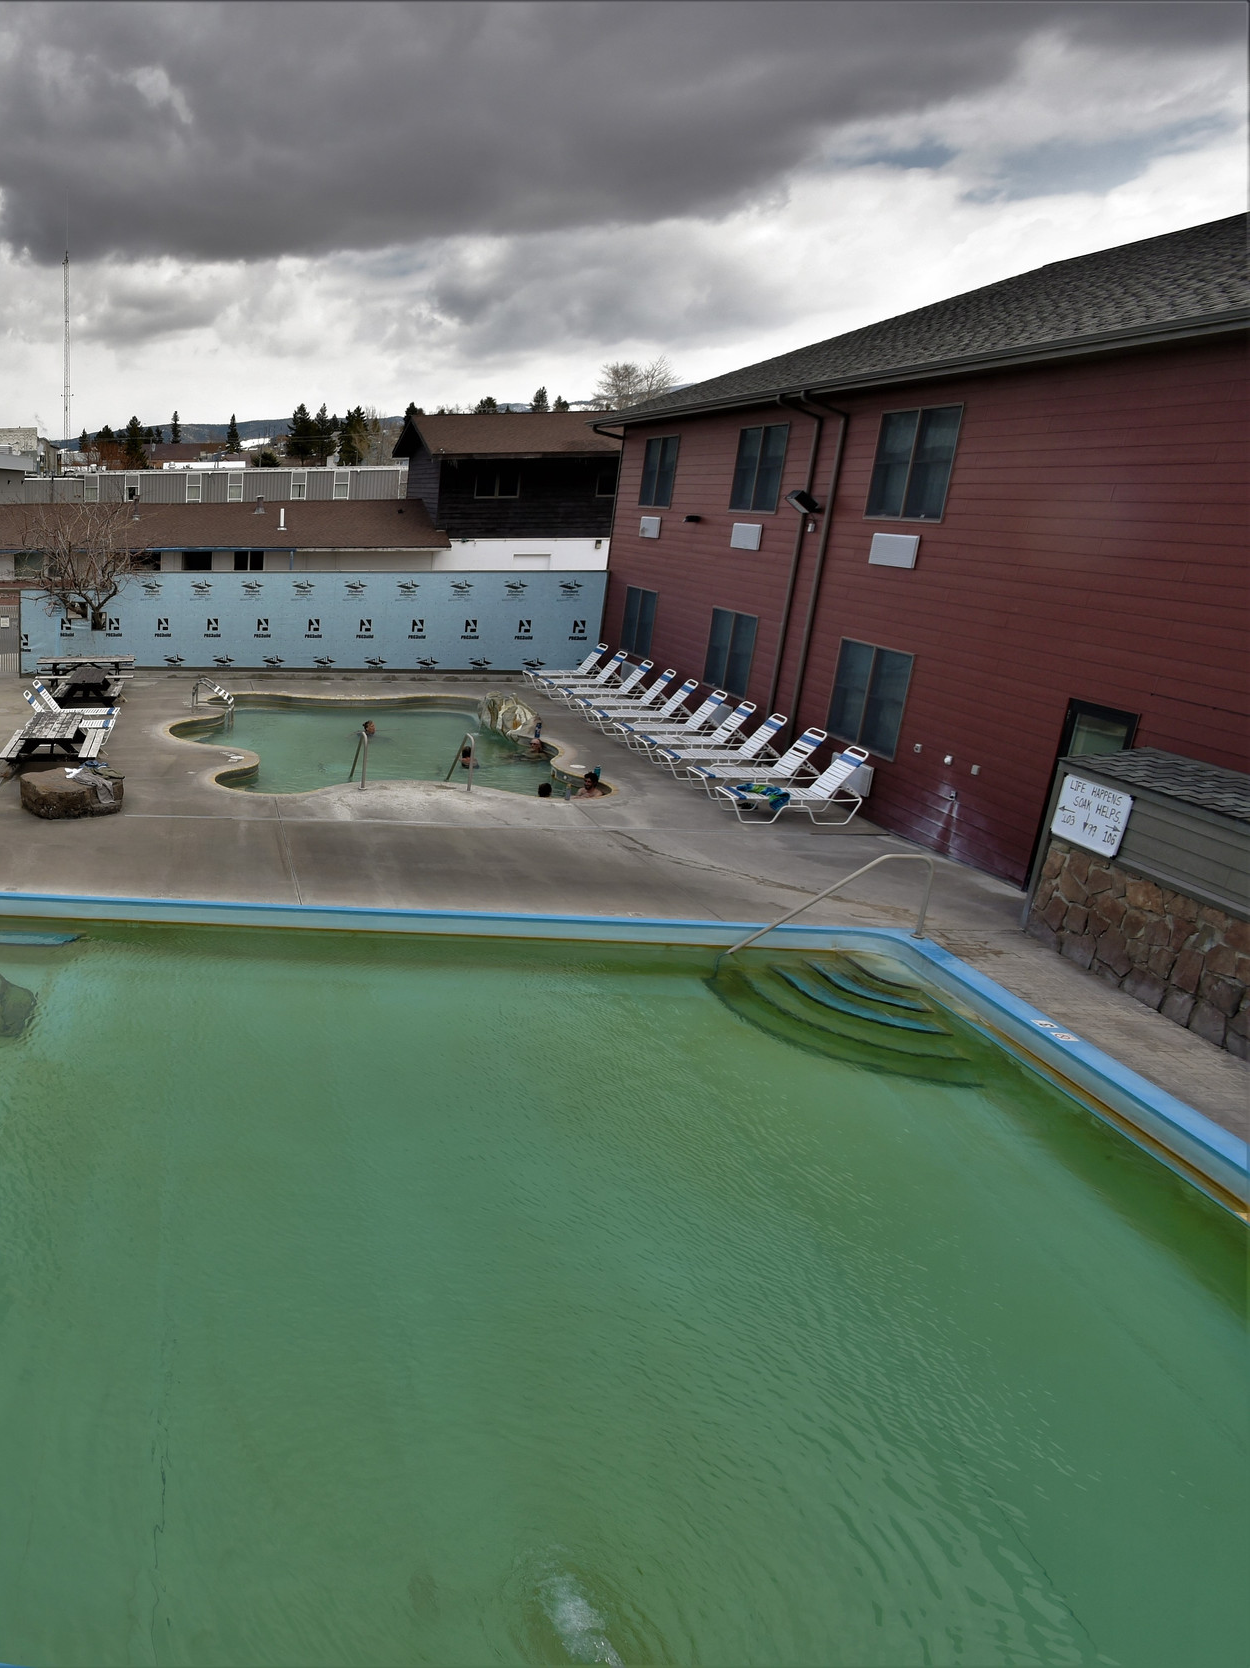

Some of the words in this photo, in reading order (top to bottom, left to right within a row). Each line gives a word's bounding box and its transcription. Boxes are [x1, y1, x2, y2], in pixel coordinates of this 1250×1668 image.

[1070, 780, 1087, 793] LIFE
[1091, 786, 1122, 806] HAPPENS
[1073, 796, 1092, 811] SOAK
[1096, 804, 1122, 824] HELPS.
[1102, 831, 1118, 845] 106
